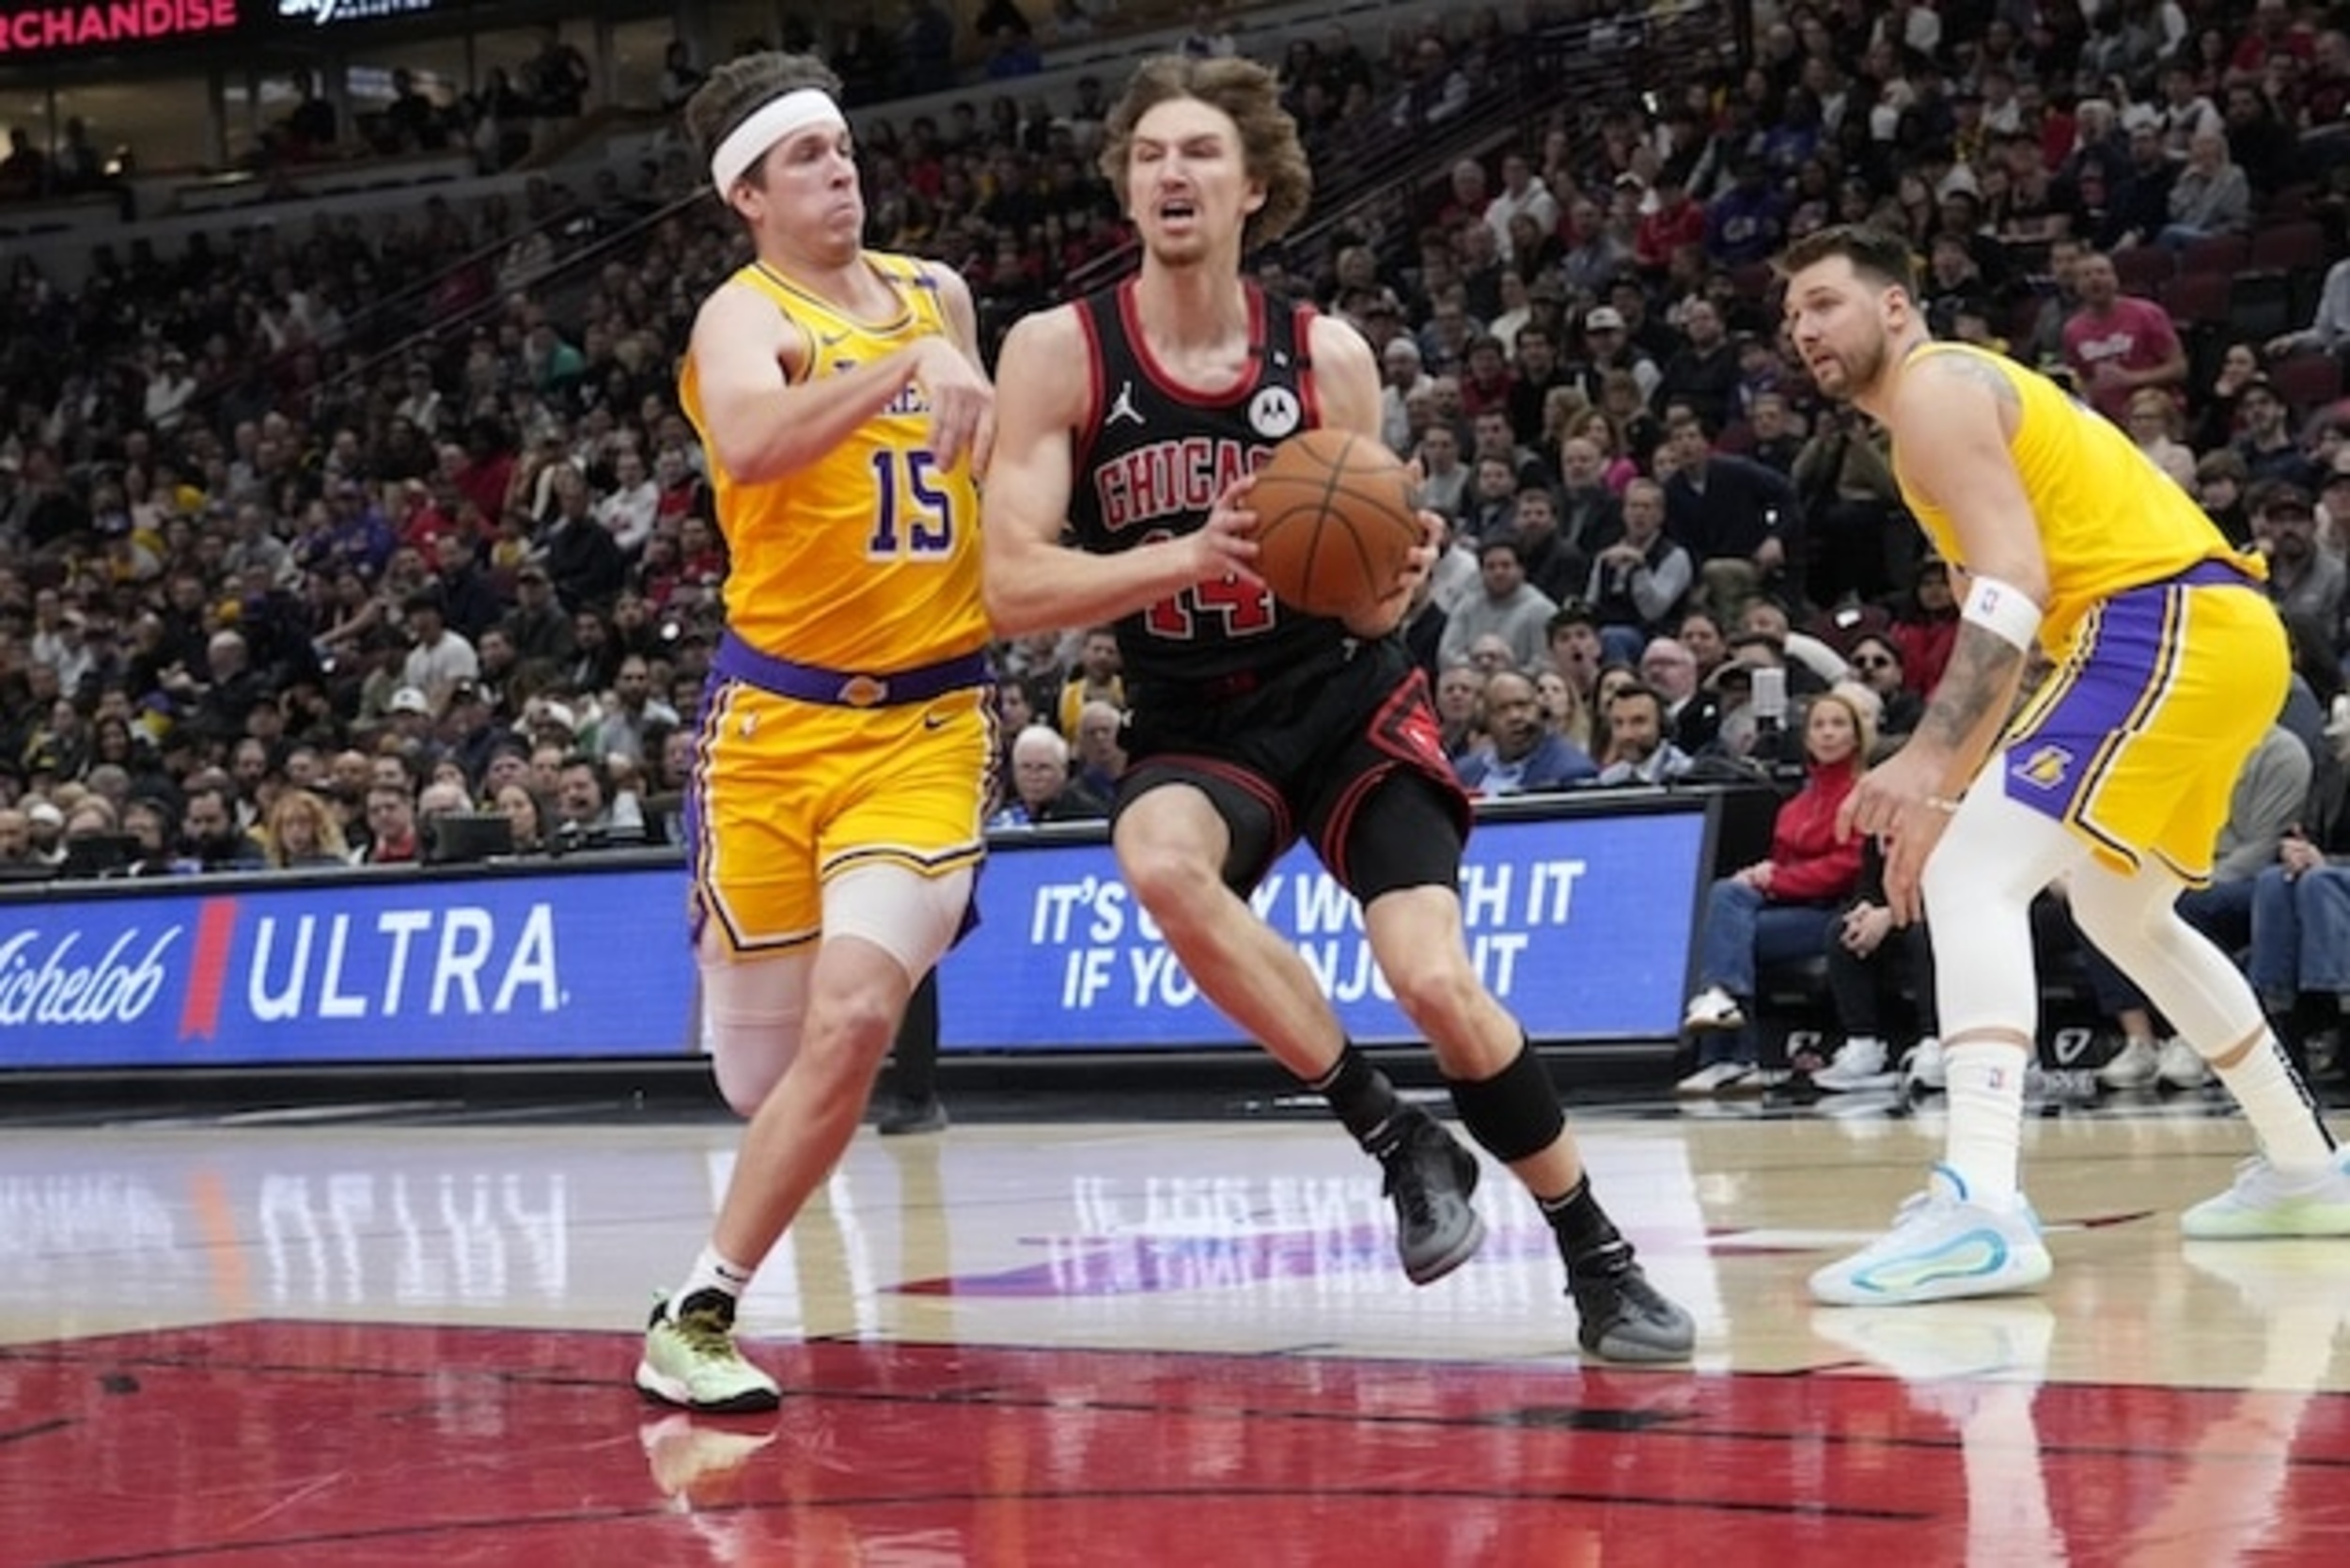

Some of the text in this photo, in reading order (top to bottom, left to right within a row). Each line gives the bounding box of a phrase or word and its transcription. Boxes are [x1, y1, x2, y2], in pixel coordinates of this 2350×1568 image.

[867, 445, 960, 562] 15
[1031, 875, 1128, 946] IT'S
[1526, 860, 1587, 925] IT
[1061, 948, 1117, 1009] IF
[1130, 947, 1198, 1008] YO
